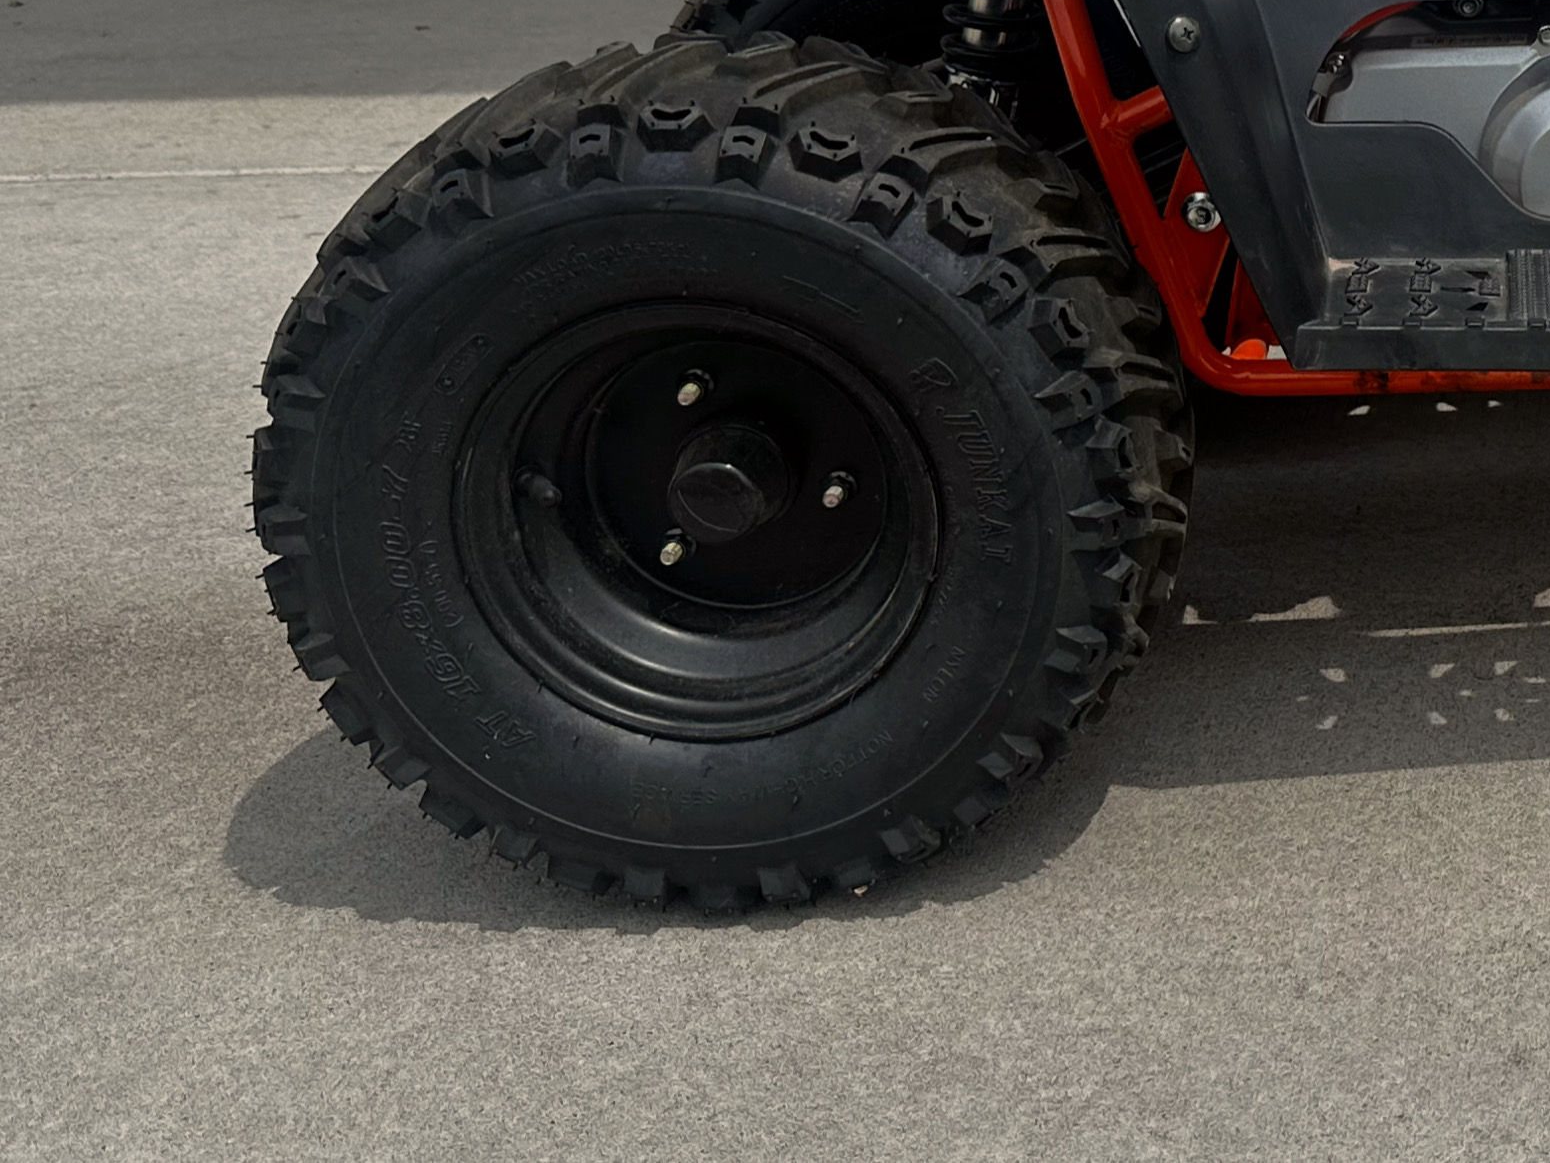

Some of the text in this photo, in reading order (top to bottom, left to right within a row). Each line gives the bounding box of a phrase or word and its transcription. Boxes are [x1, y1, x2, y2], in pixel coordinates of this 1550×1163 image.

[934, 404, 1013, 563] JUNKAI
[919, 645, 969, 703] NYLON
[474, 708, 537, 749] AT
